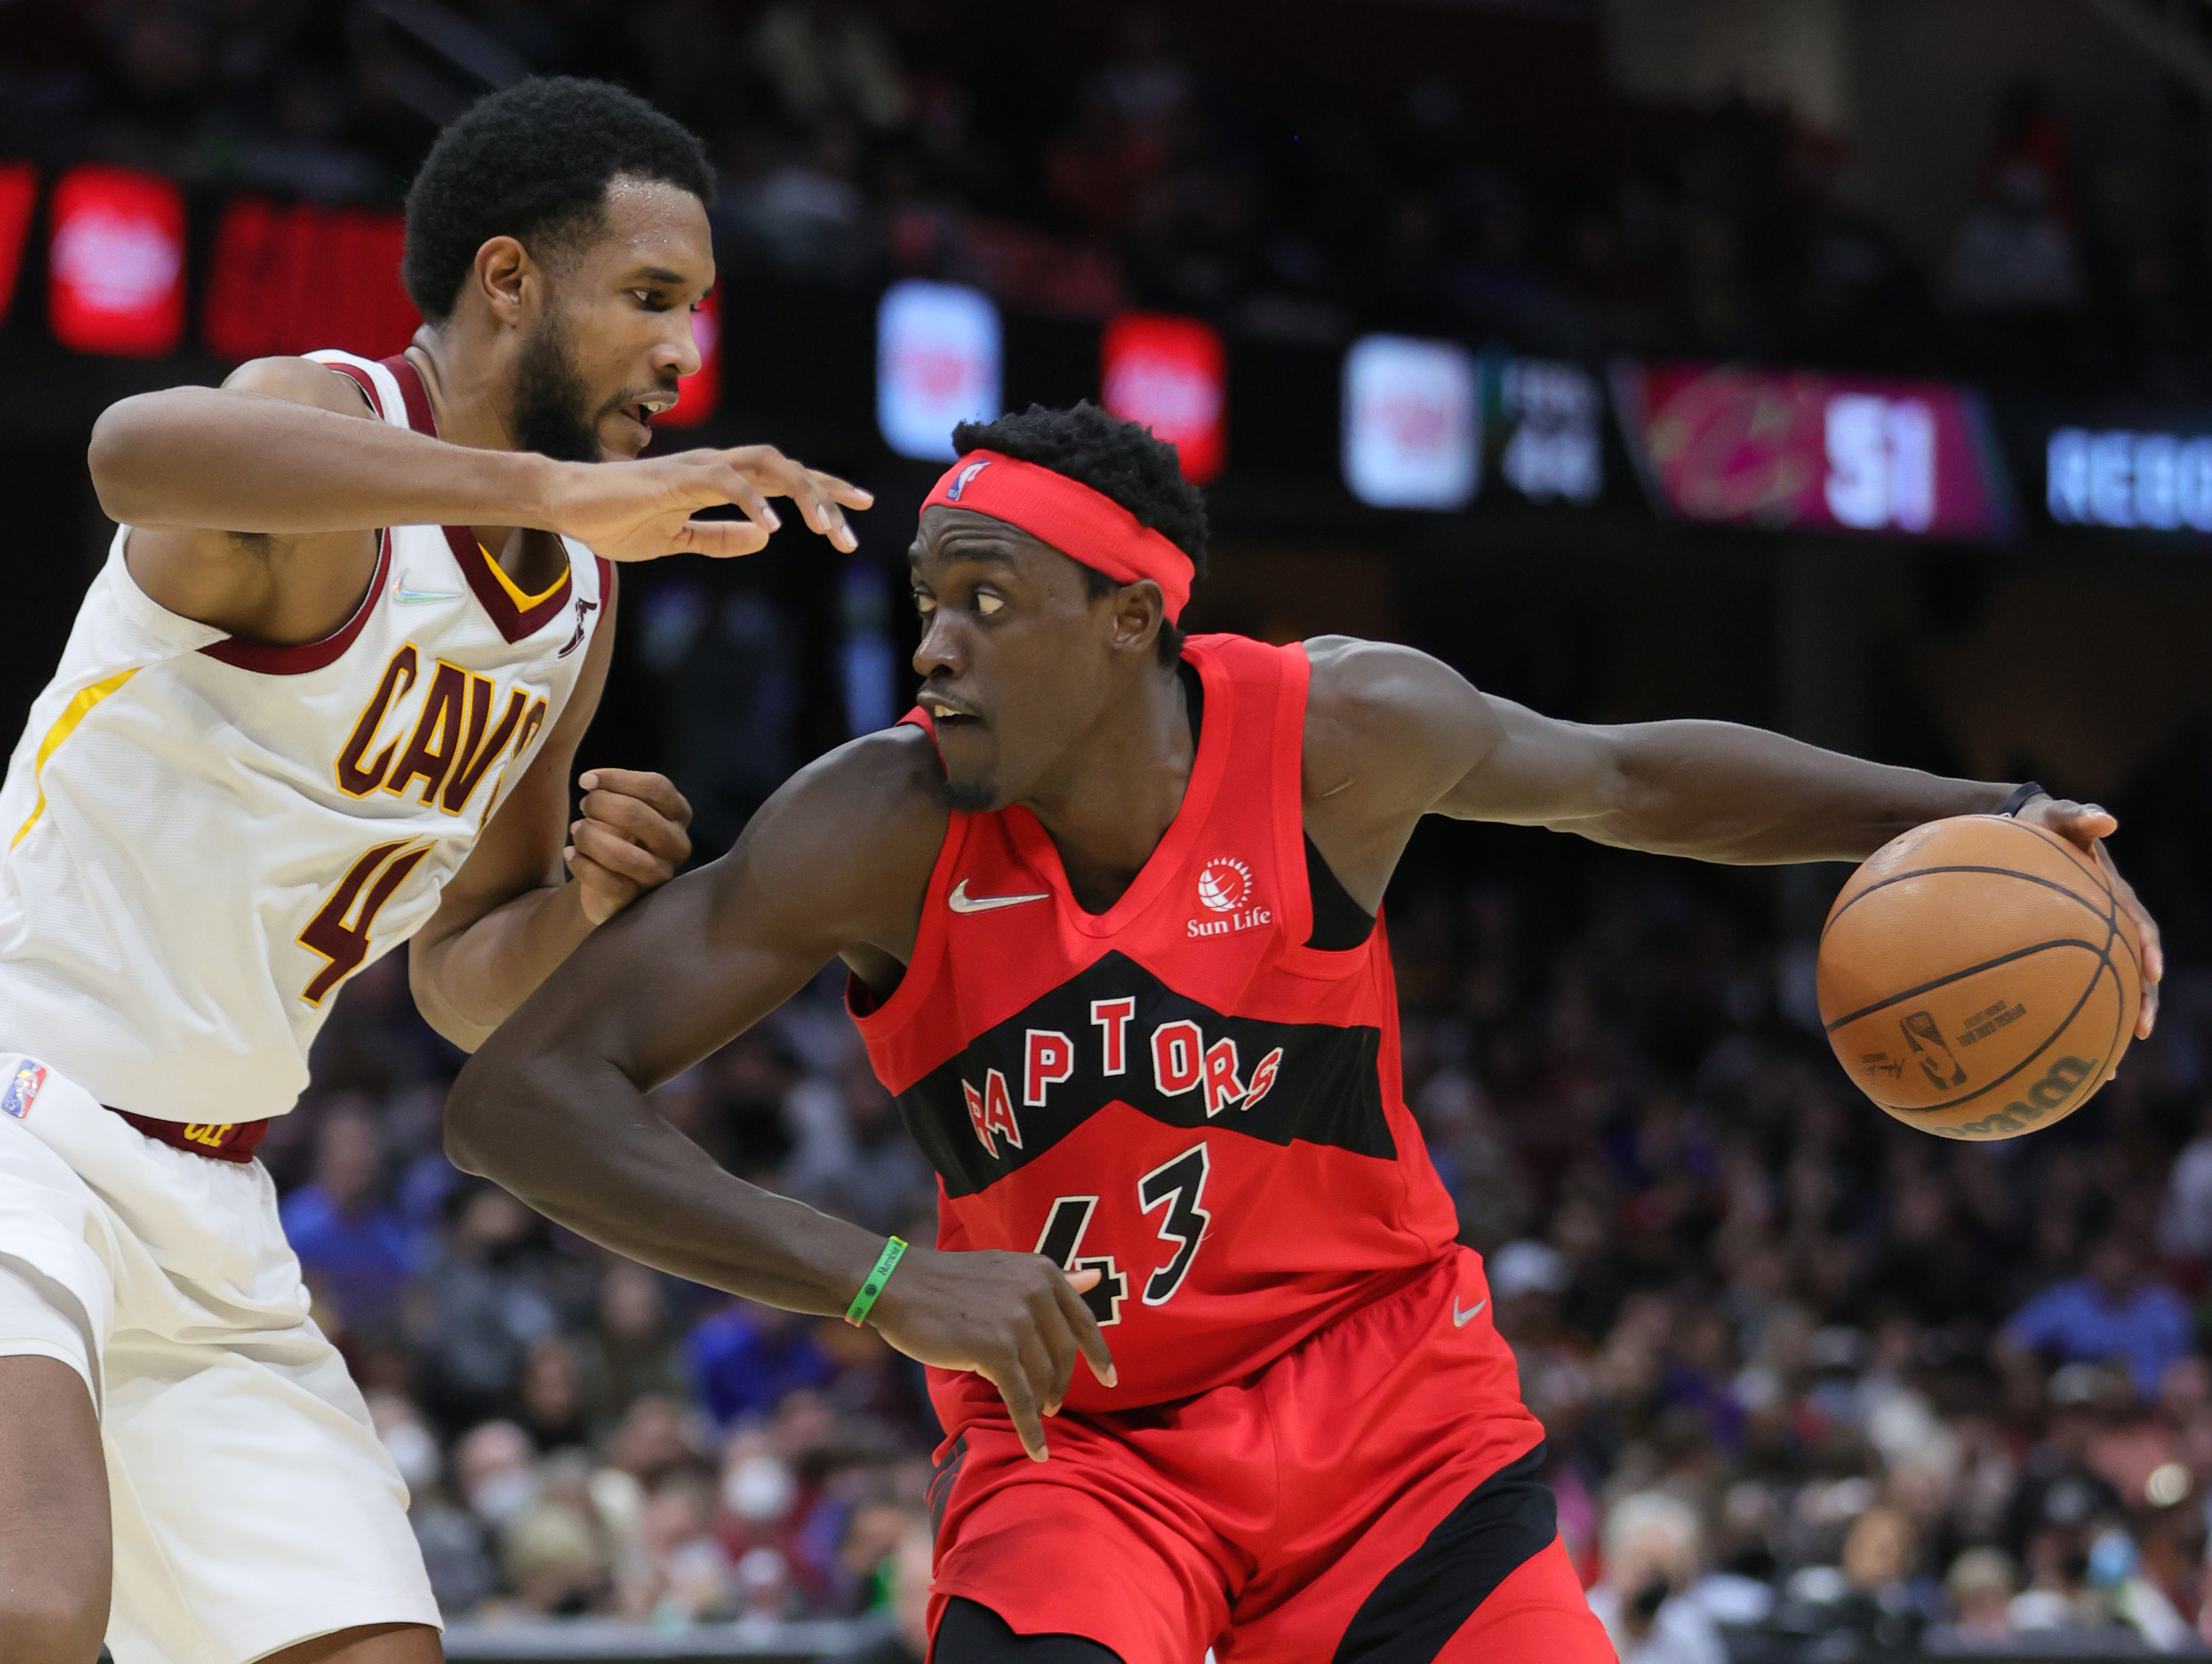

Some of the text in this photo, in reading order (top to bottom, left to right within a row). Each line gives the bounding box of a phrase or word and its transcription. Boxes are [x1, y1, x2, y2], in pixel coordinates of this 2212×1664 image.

[295, 834, 439, 1007] 4
[1187, 906, 1271, 938] Sun Life
[961, 995, 1283, 1159] RAPTORS
[1034, 1141, 1210, 1327] 43
